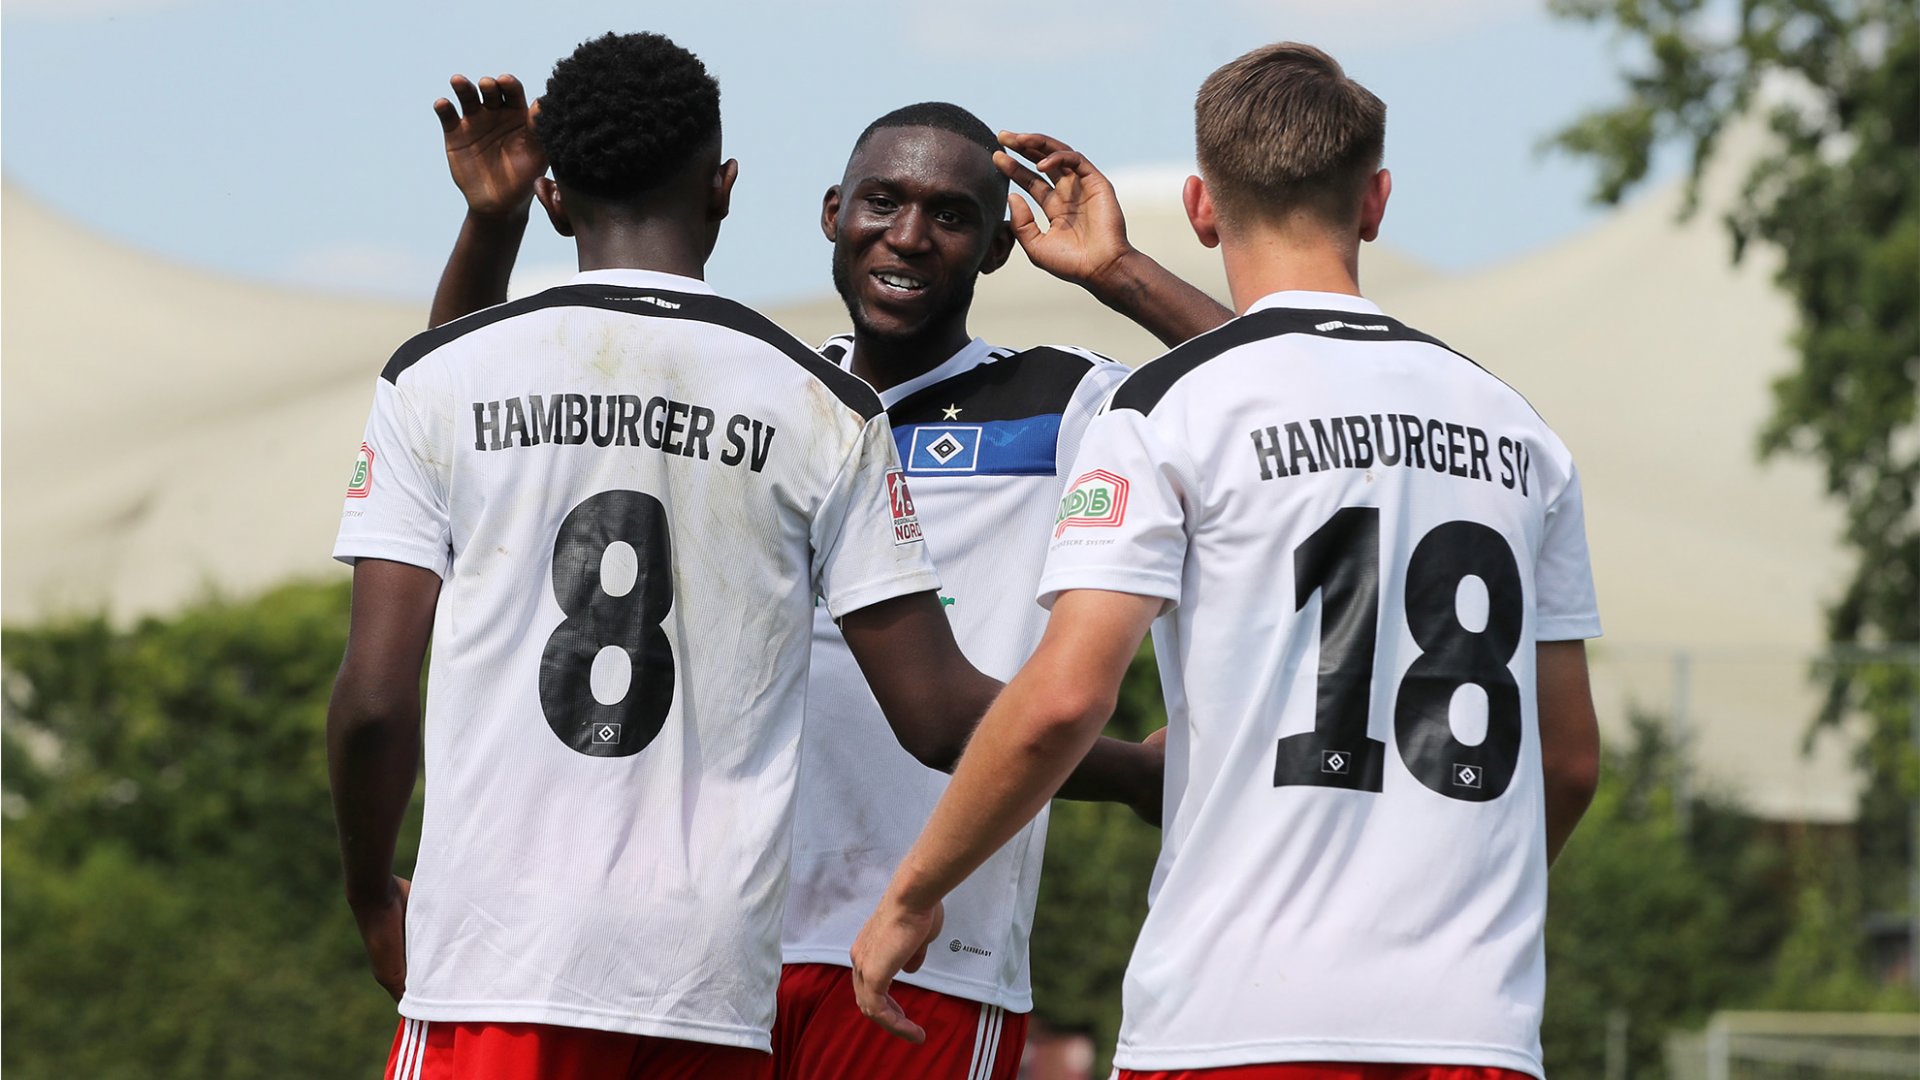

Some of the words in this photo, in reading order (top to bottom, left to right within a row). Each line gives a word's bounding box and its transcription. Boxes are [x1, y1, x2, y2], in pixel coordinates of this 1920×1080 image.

[472, 393, 716, 461] HAMBURGER
[720, 413, 776, 474] SV
[1250, 413, 1493, 482] HAMBURGER
[1498, 435, 1530, 498] SV
[895, 523, 923, 541] NORD
[538, 489, 676, 758] 8
[1273, 506, 1524, 803] 18
